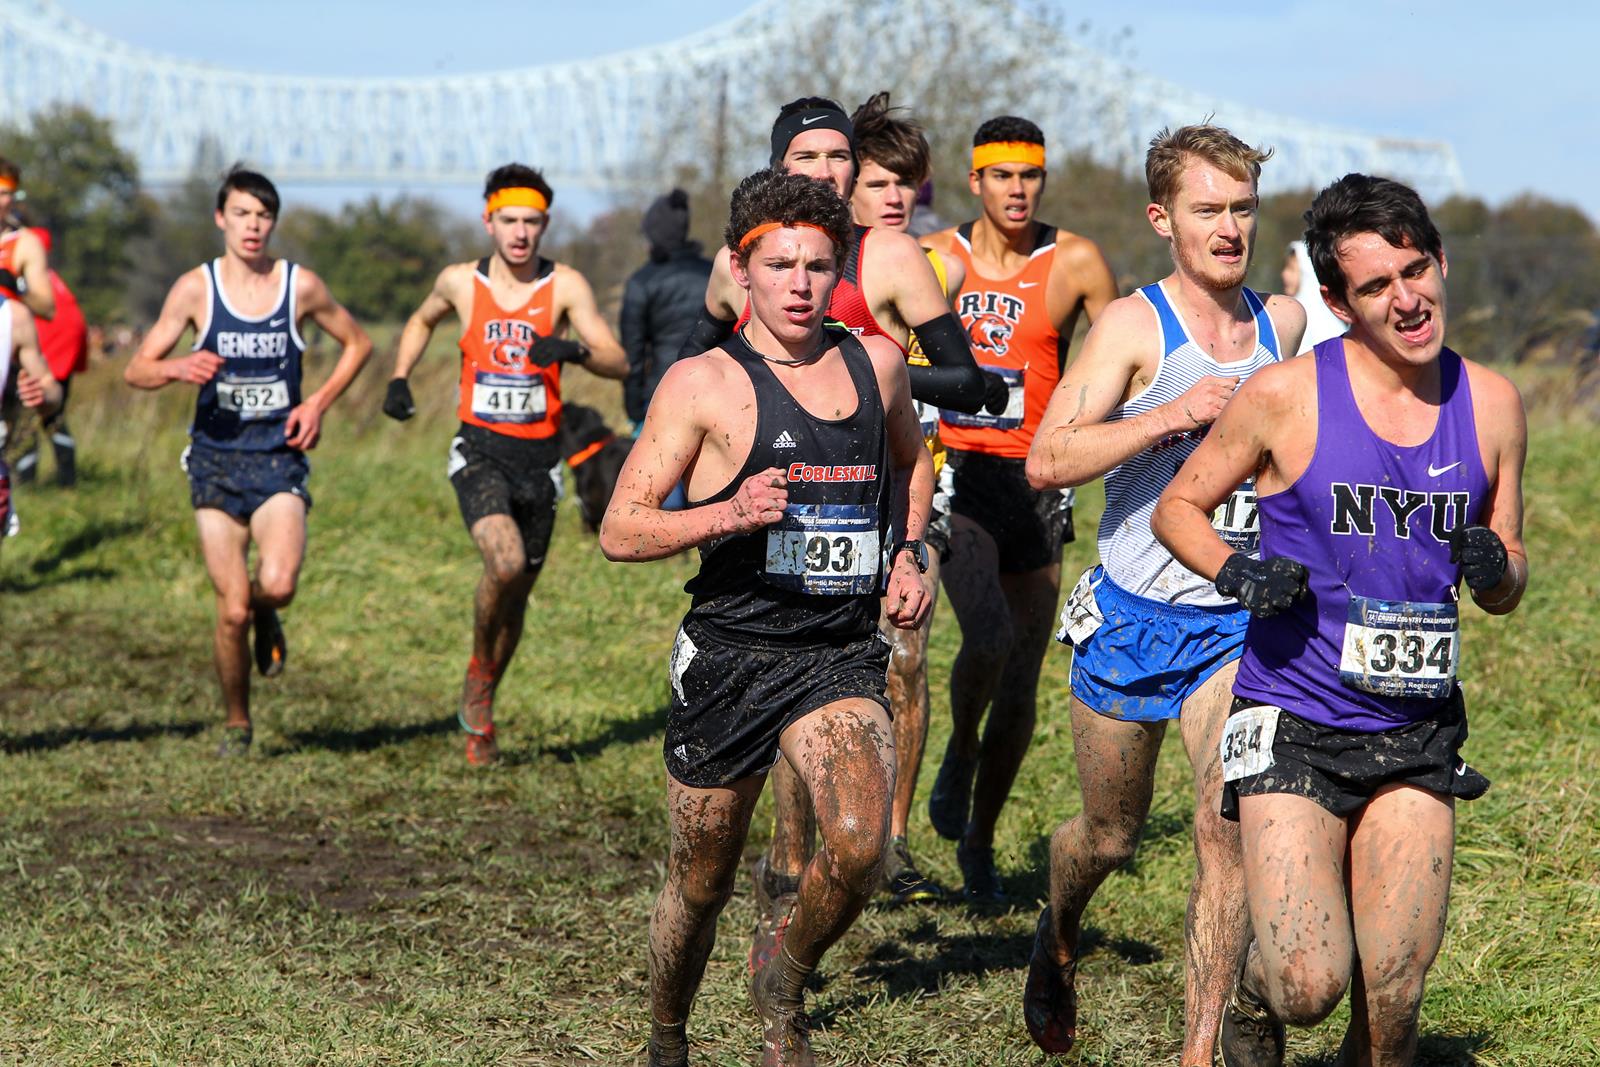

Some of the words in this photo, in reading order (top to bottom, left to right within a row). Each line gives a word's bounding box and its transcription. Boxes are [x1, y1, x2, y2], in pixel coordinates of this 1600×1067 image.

[959, 291, 1024, 321] RIT
[217, 331, 288, 358] GENESEO
[485, 319, 534, 343] RIT
[231, 388, 274, 407] 652
[487, 391, 531, 410] 417
[787, 462, 878, 482] COBLESKILL
[1210, 494, 1258, 529] 17
[1330, 482, 1470, 543] NYU
[806, 535, 853, 573] 93
[1370, 633, 1452, 674] 334
[1408, 682, 1438, 690] Regional
[1223, 725, 1263, 763] 334
